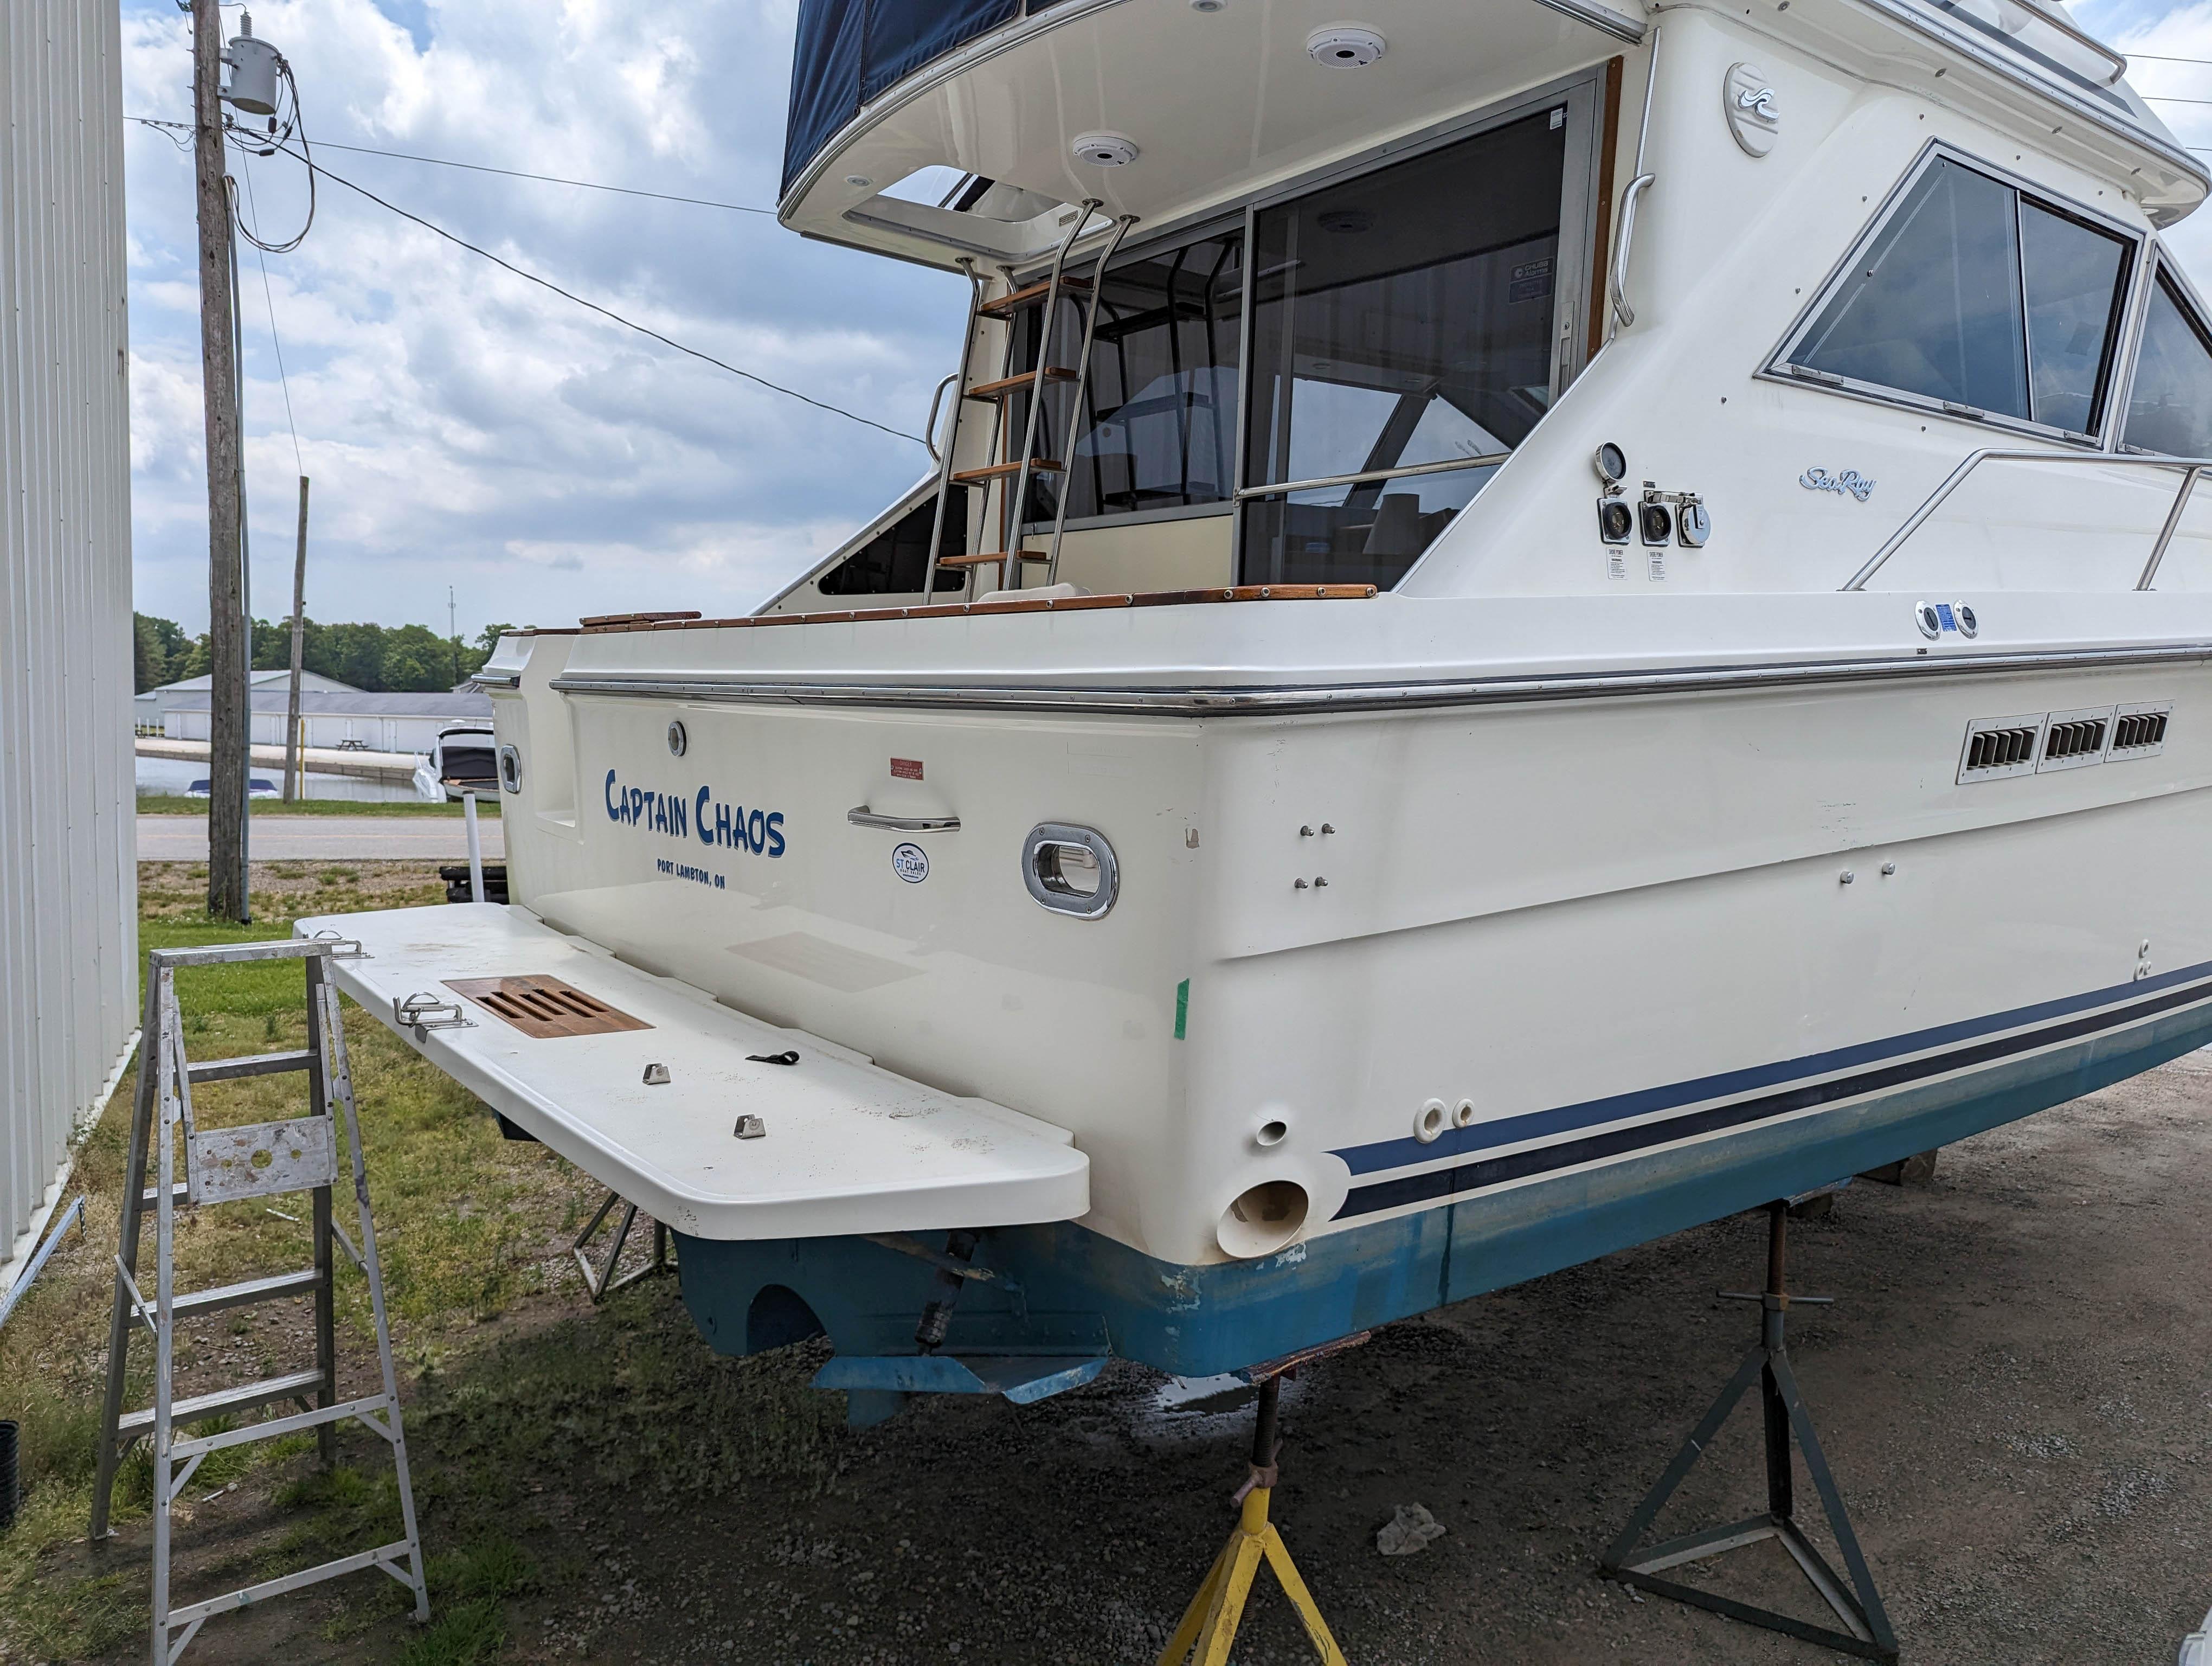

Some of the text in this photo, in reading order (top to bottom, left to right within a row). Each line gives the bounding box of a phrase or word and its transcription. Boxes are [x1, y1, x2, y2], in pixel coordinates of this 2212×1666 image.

[1799, 466, 1877, 502] Sea Ray
[657, 858, 726, 889] PORT LAMBTON, ON
[897, 859, 925, 873] ST CLAIR
